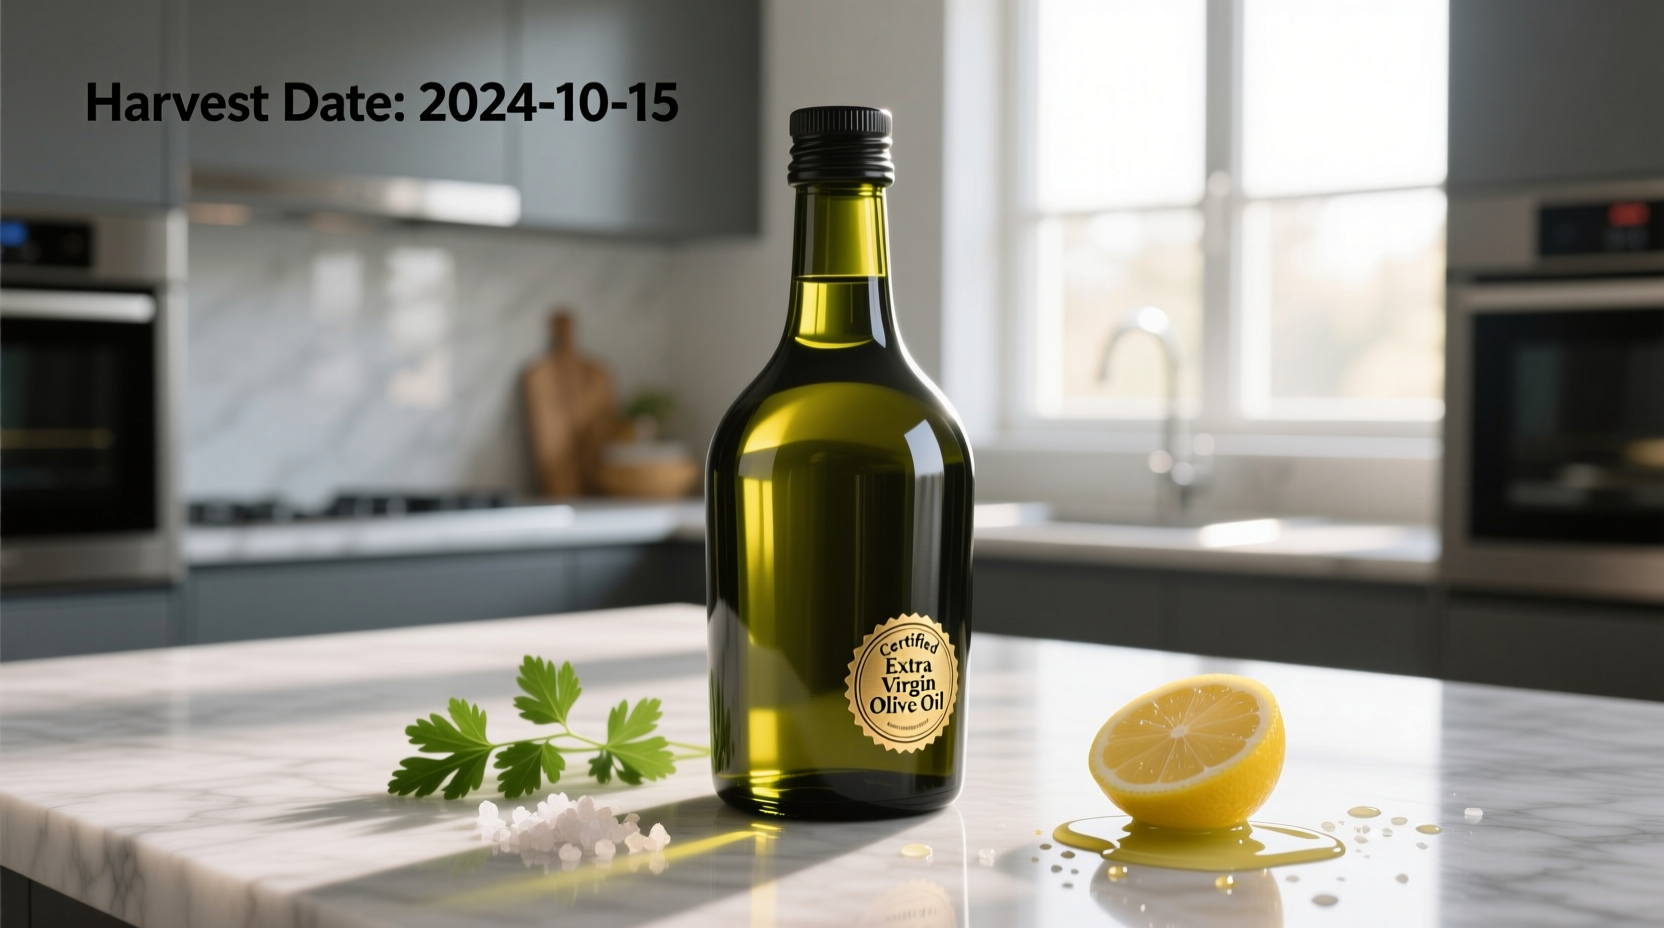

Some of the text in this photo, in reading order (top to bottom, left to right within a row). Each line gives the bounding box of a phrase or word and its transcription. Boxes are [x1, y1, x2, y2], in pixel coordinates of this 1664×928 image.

[879, 632, 940, 657] Certified
[885, 657, 932, 675] Extra
[881, 674, 936, 697] Virgin
[869, 690, 944, 714] Olive Oil
